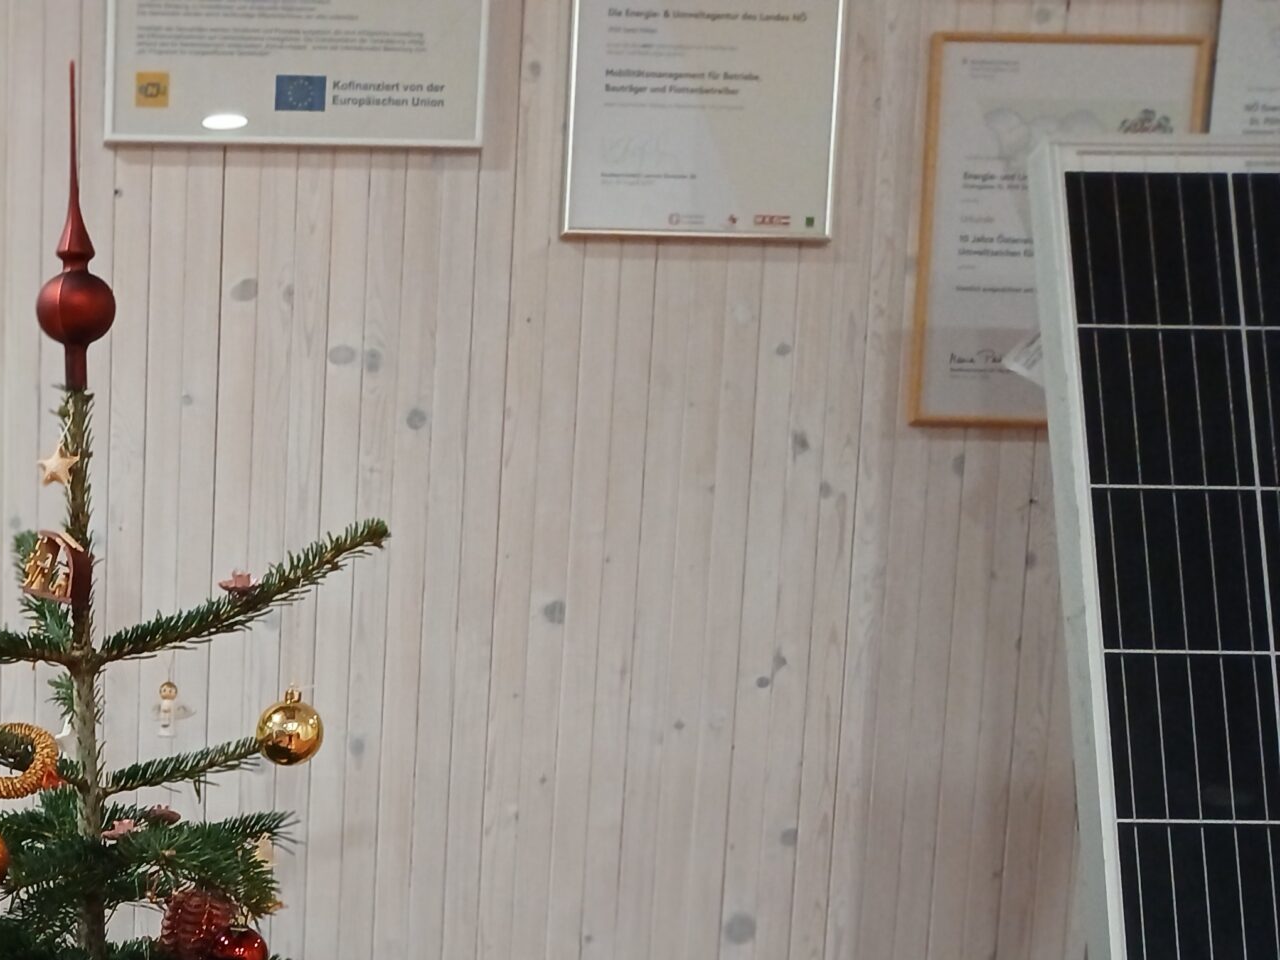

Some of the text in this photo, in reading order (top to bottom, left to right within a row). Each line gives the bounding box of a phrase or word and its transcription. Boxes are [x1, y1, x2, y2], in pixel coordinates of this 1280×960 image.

[332, 81, 445, 93] Kofinanziert von der
[332, 94, 445, 108] Europäischen Union
